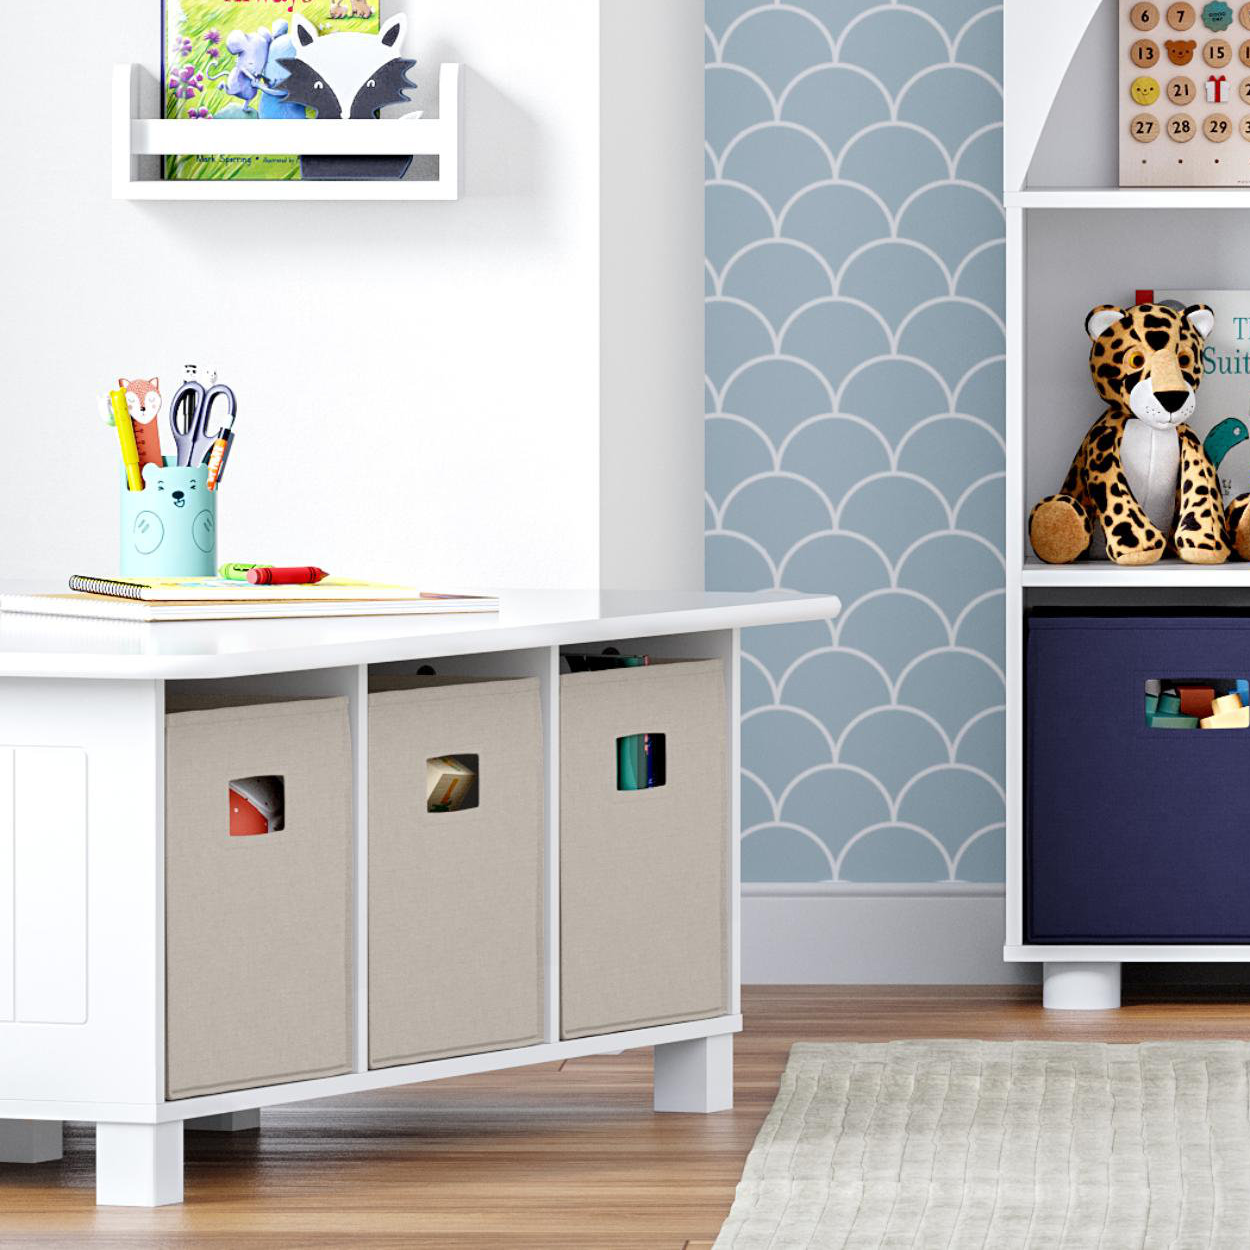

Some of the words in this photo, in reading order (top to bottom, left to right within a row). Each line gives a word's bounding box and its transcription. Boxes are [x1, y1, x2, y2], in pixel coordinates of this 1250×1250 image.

[1141, 10, 1149, 22] 6
[1176, 10, 1185, 22] 7
[1138, 48, 1154, 60] 13
[1210, 47, 1225, 59] 15
[1173, 84, 1189, 97] 21
[1136, 122, 1153, 134] 27
[1172, 121, 1190, 133] 28
[1210, 121, 1227, 133] 29
